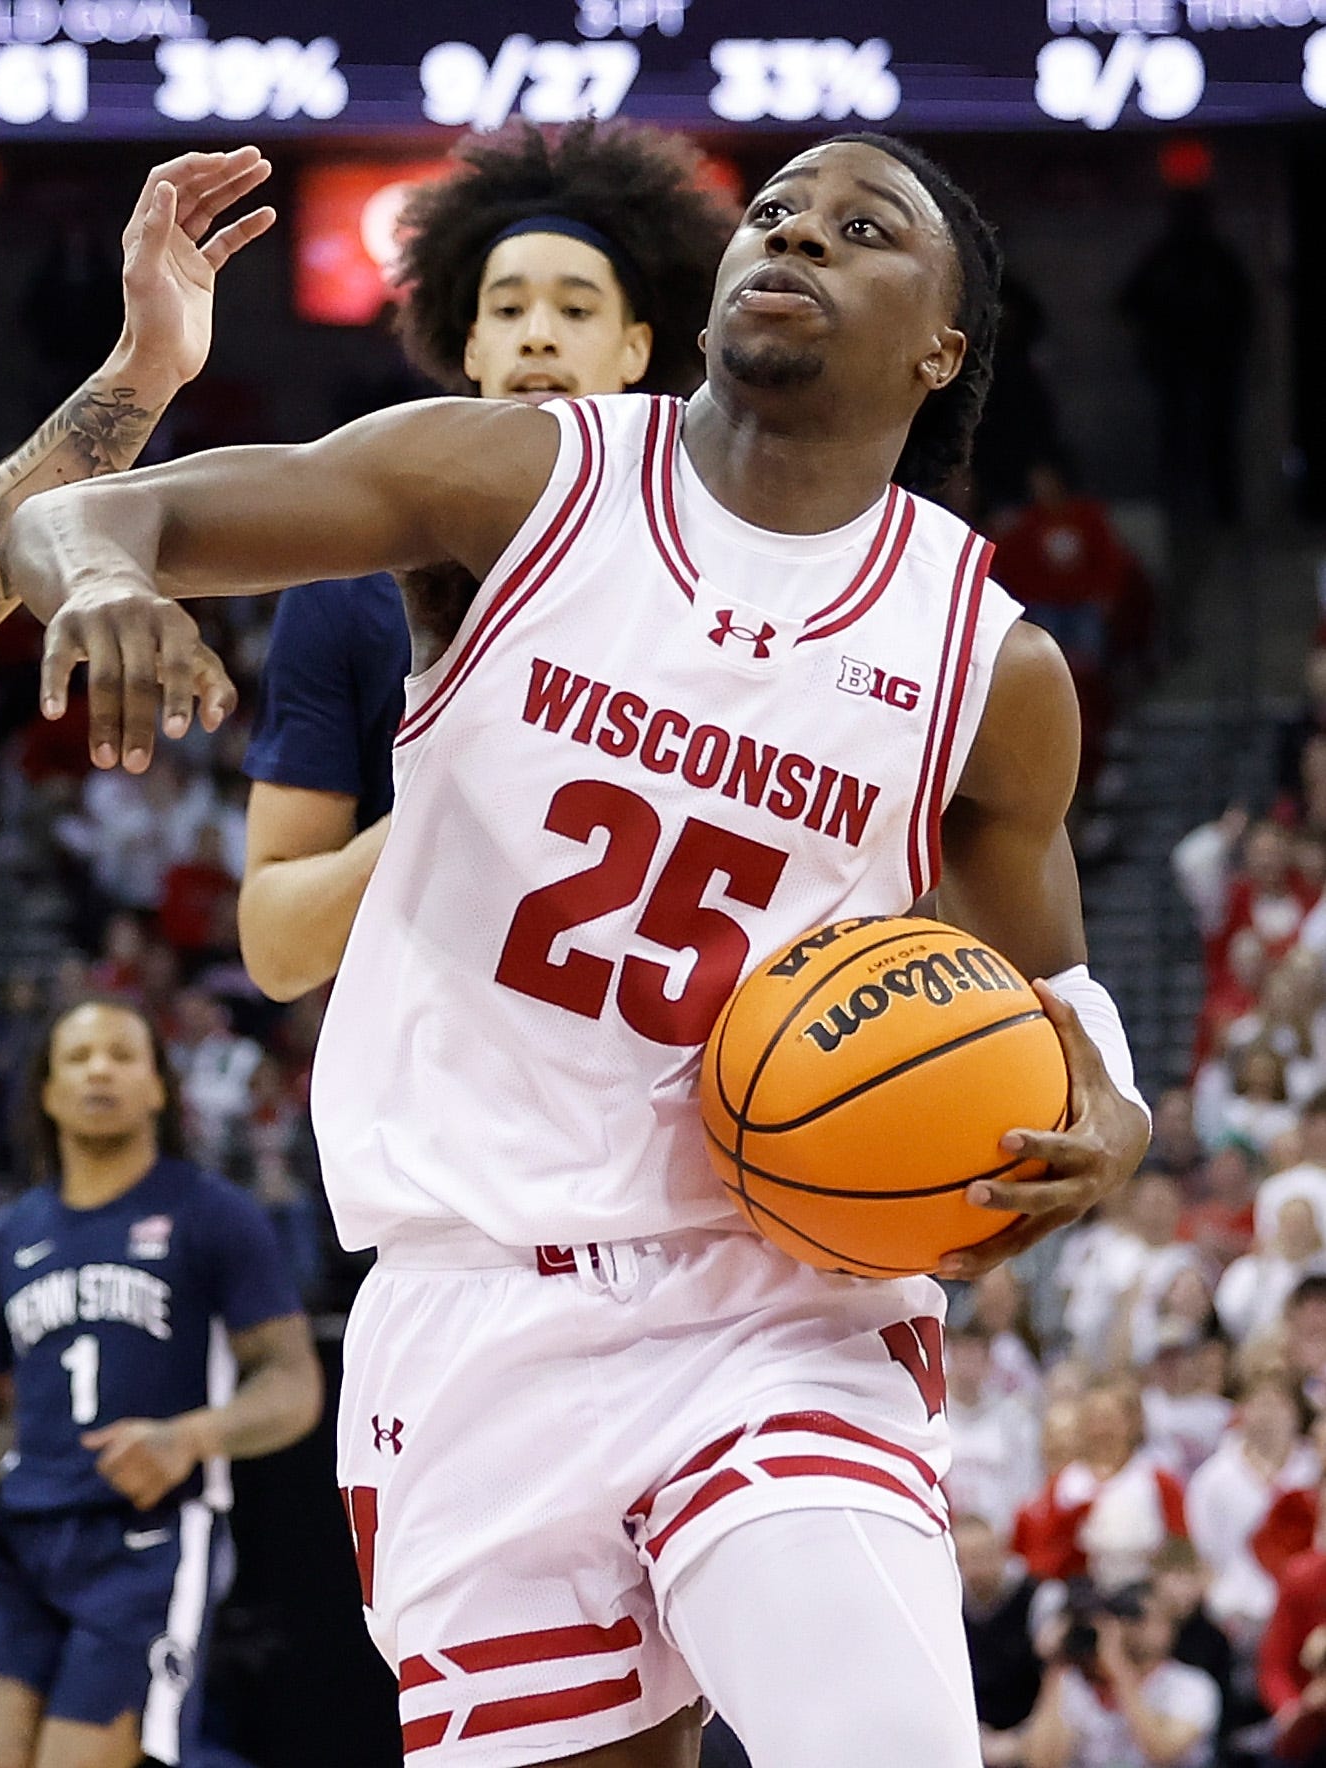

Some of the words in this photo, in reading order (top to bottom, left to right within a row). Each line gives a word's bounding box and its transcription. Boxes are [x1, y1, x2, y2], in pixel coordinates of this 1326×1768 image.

[155, 36, 349, 122] 39%
[708, 35, 901, 122] 33%
[522, 657, 881, 847] WISCONSIN
[494, 778, 790, 1046] 25
[802, 946, 1024, 1053] Wilson
[4, 1267, 78, 1356] PENN
[78, 1262, 173, 1341] STATE
[60, 1333, 101, 1426] 1
